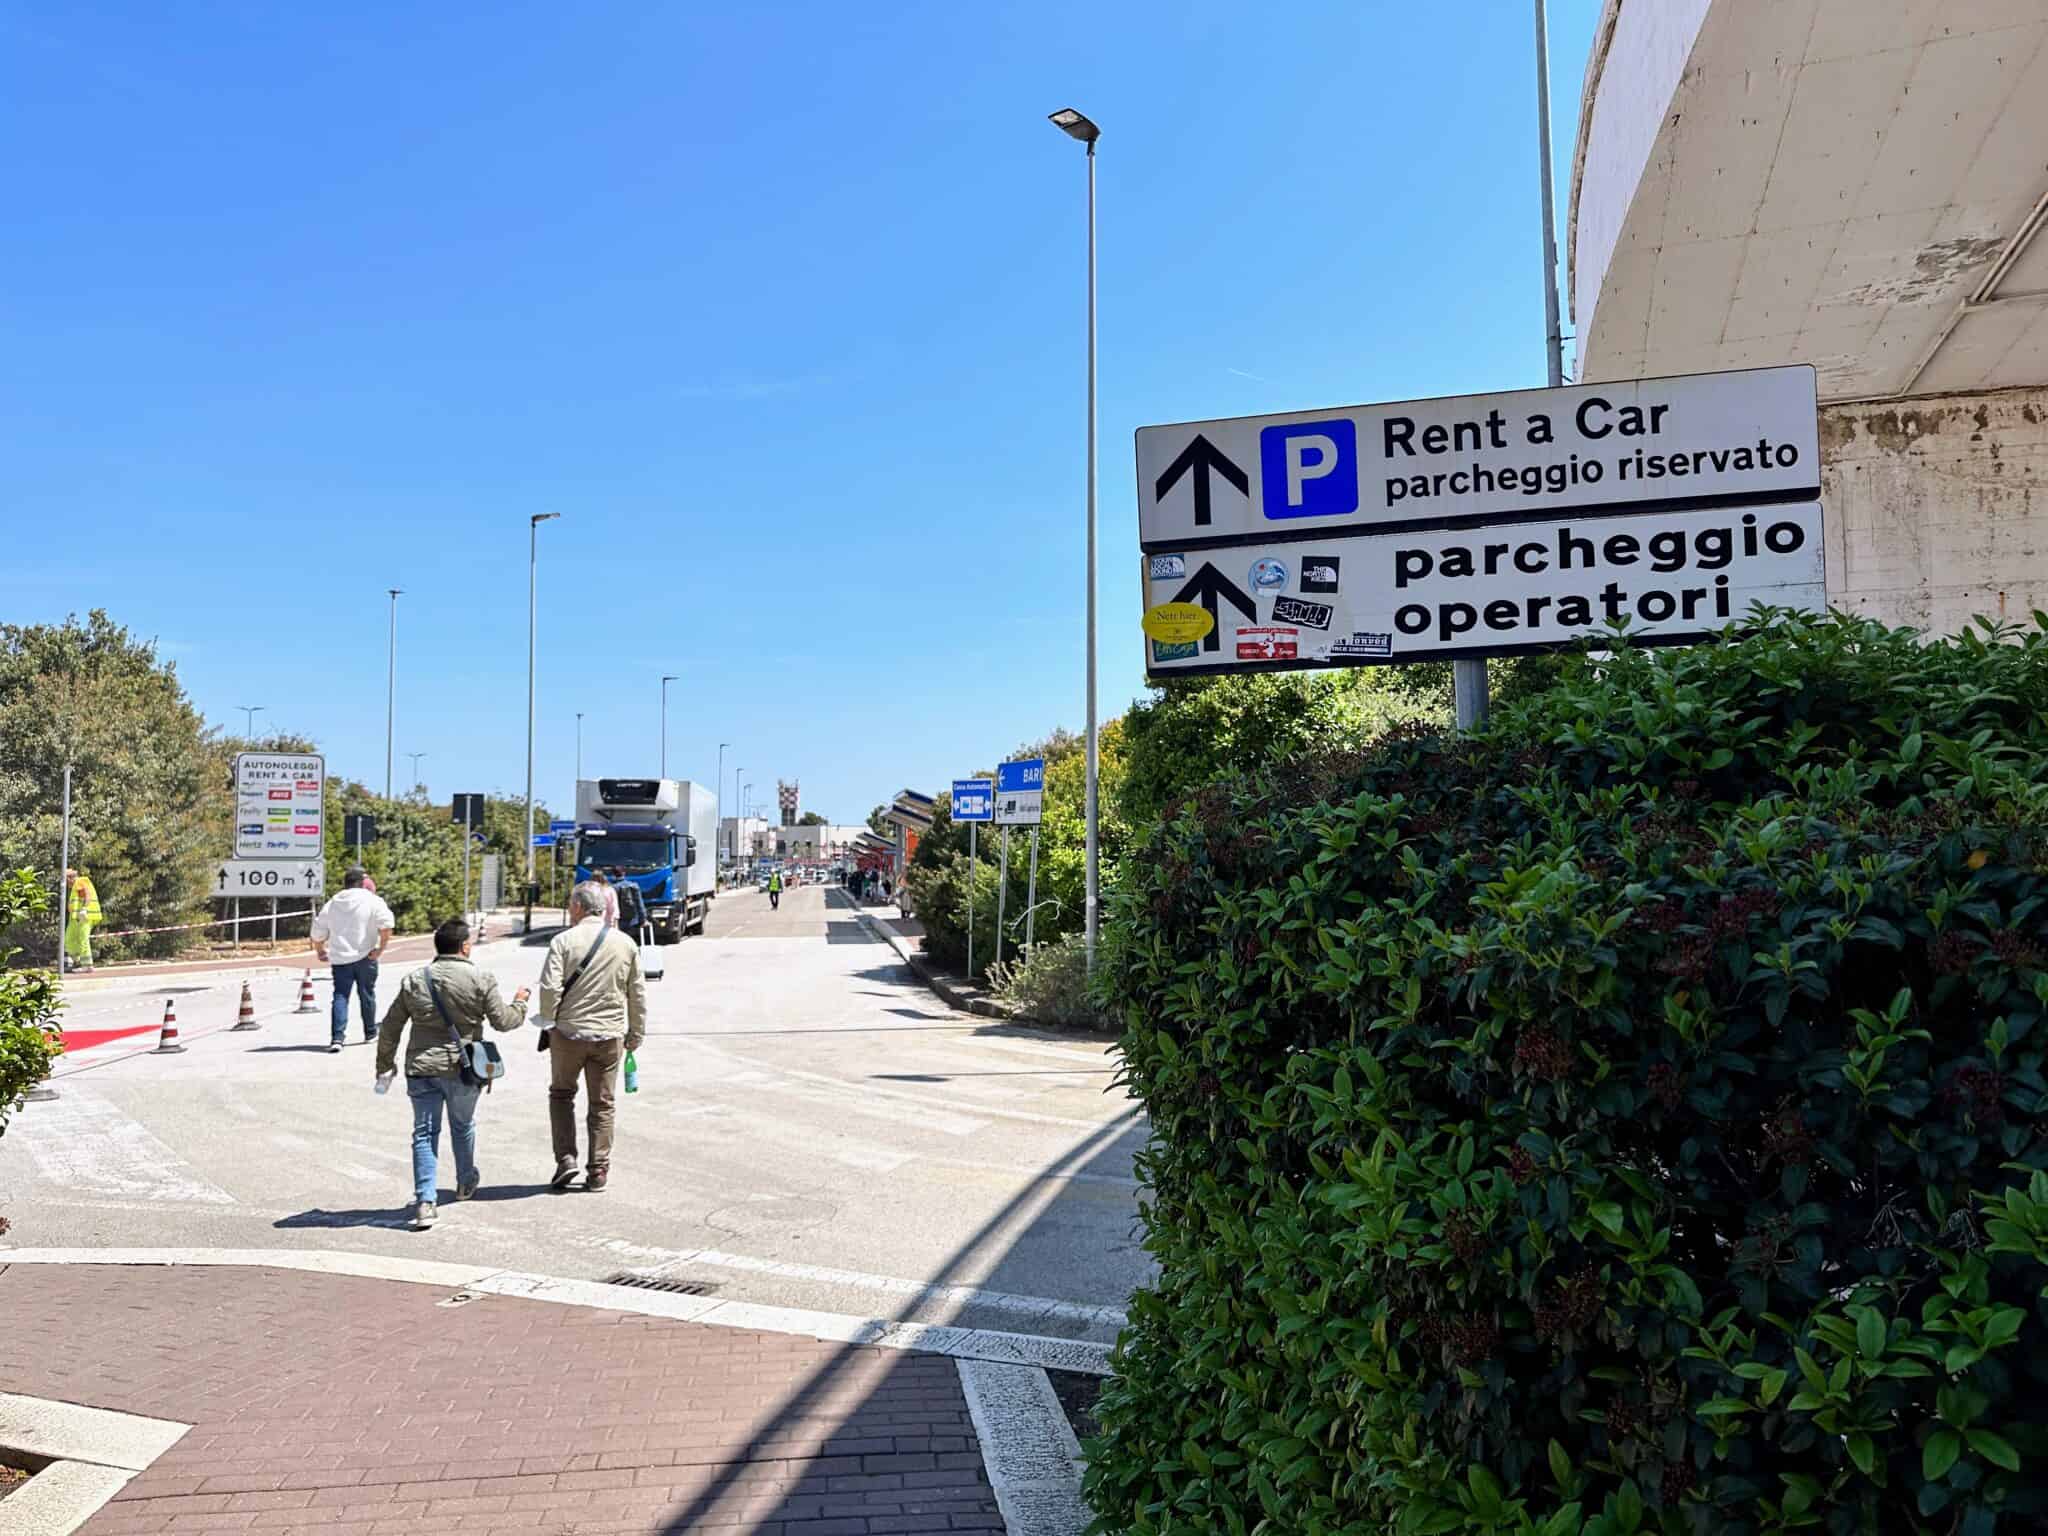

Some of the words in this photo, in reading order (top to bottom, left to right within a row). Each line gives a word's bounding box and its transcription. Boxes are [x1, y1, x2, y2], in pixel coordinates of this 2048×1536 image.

[1384, 409, 1507, 458] Rent
[1526, 414, 1554, 444] a
[1575, 398, 1669, 440] Car
[1286, 434, 1338, 506] P
[1386, 454, 1603, 507] parcheggio
[1618, 439, 1798, 480] riservato
[1395, 513, 1805, 588] parcheggio
[1394, 574, 1730, 640] operatori
[244, 761, 319, 770] AUTONOLEGGI
[1023, 767, 1042, 783] BARI
[240, 870, 279, 886] 100
[282, 877, 295, 886] m
